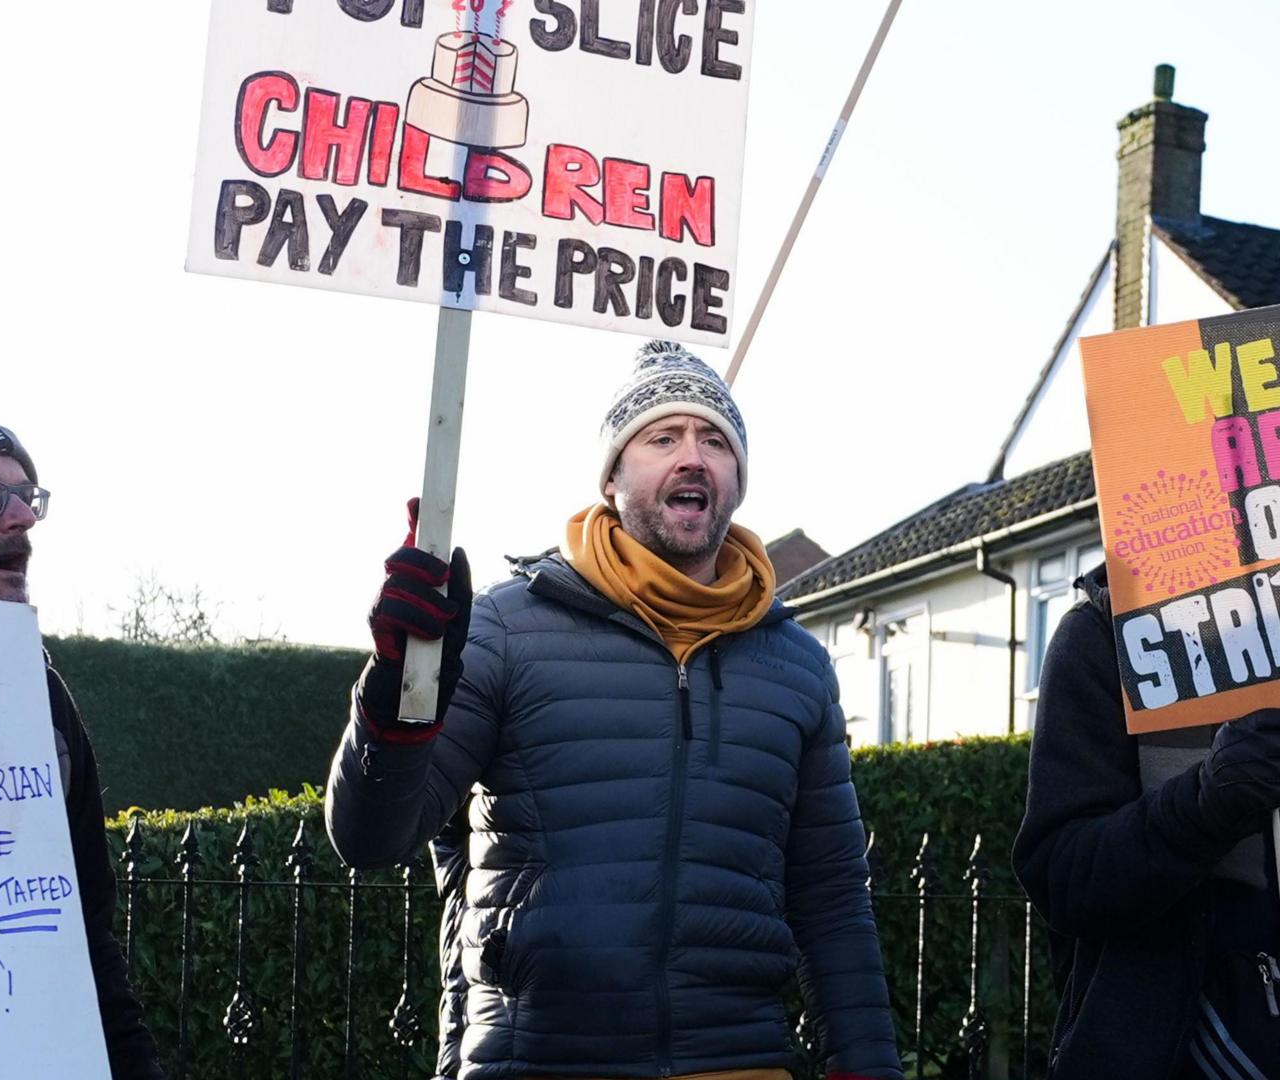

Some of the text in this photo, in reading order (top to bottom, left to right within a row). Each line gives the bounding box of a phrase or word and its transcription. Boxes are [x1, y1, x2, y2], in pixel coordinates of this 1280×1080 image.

[529, 0, 746, 81] SLICE
[235, 70, 716, 248] CHILDREN
[214, 178, 730, 334] PAY THE PRICE
[1113, 504, 1243, 559] education
[1141, 494, 1204, 527] national
[1159, 540, 1206, 564] union
